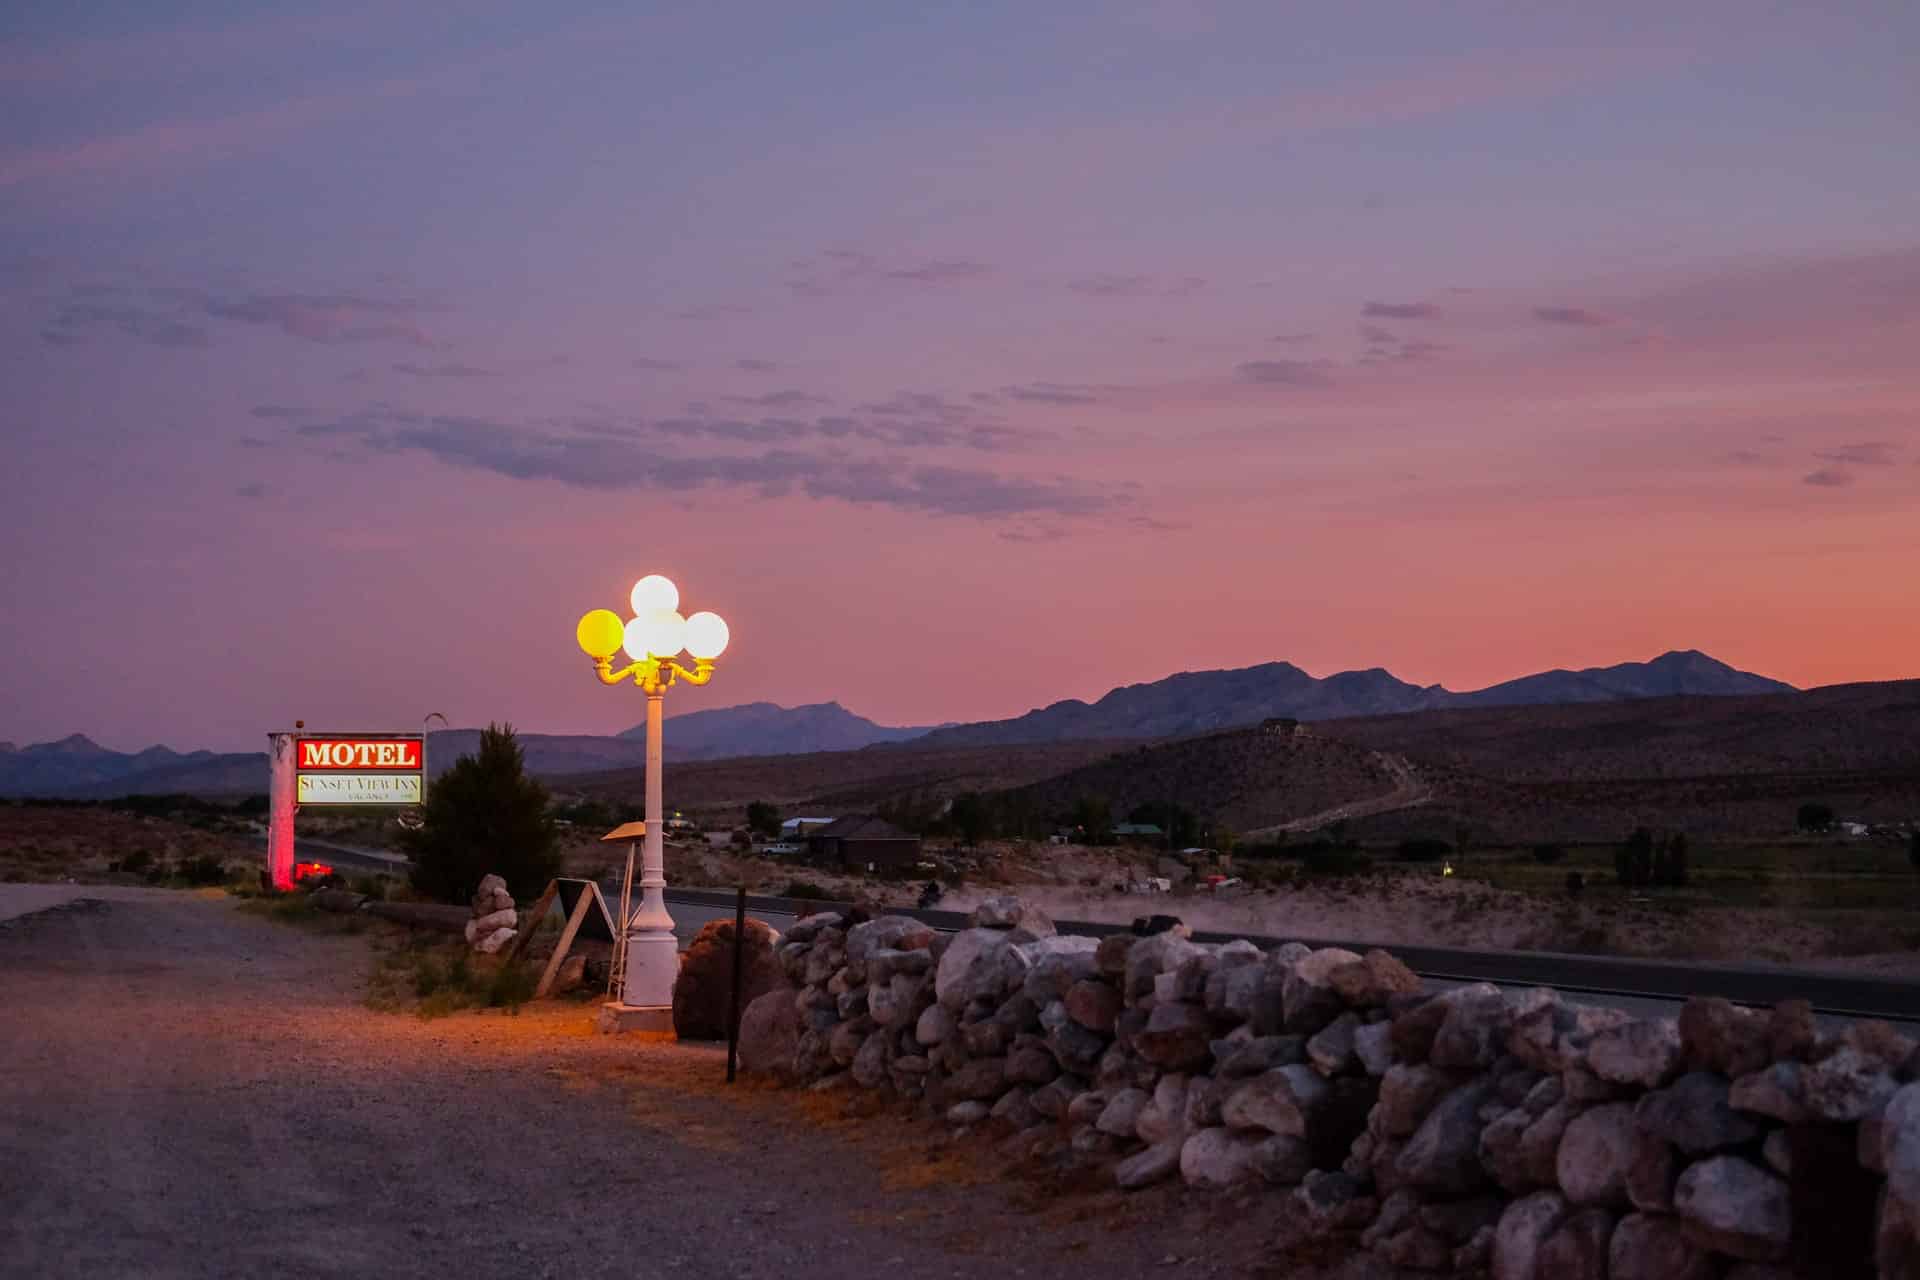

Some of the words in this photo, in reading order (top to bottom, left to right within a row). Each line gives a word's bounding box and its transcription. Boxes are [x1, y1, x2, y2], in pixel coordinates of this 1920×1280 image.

[303, 743, 416, 766] MOTEL
[300, 777, 354, 790] SUNSET
[357, 777, 391, 790] VIEW
[394, 777, 419, 790] INN
